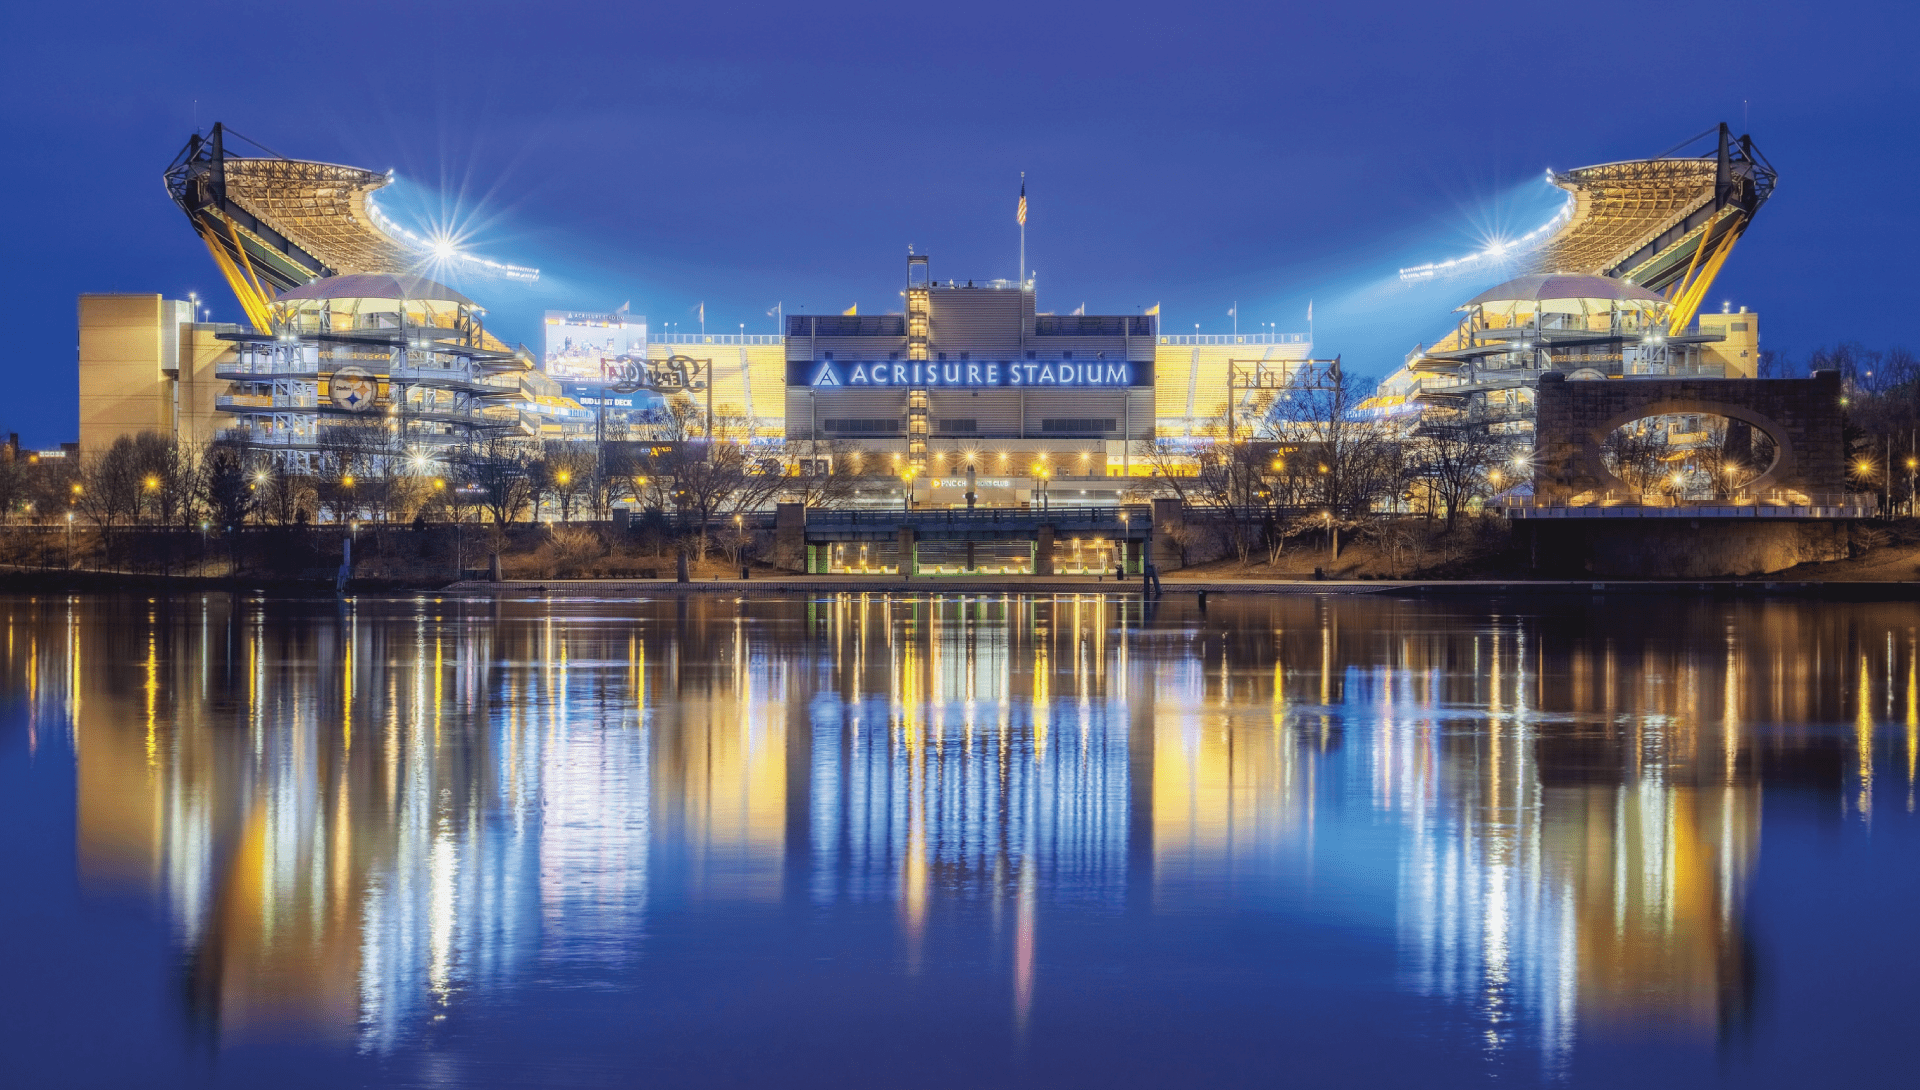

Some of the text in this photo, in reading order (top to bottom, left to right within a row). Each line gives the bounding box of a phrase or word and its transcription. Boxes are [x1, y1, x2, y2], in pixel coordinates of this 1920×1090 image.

[851, 364, 1128, 384] ACRISURE STADIUM
[580, 397, 594, 405] BUD
[614, 398, 633, 407] DECK
